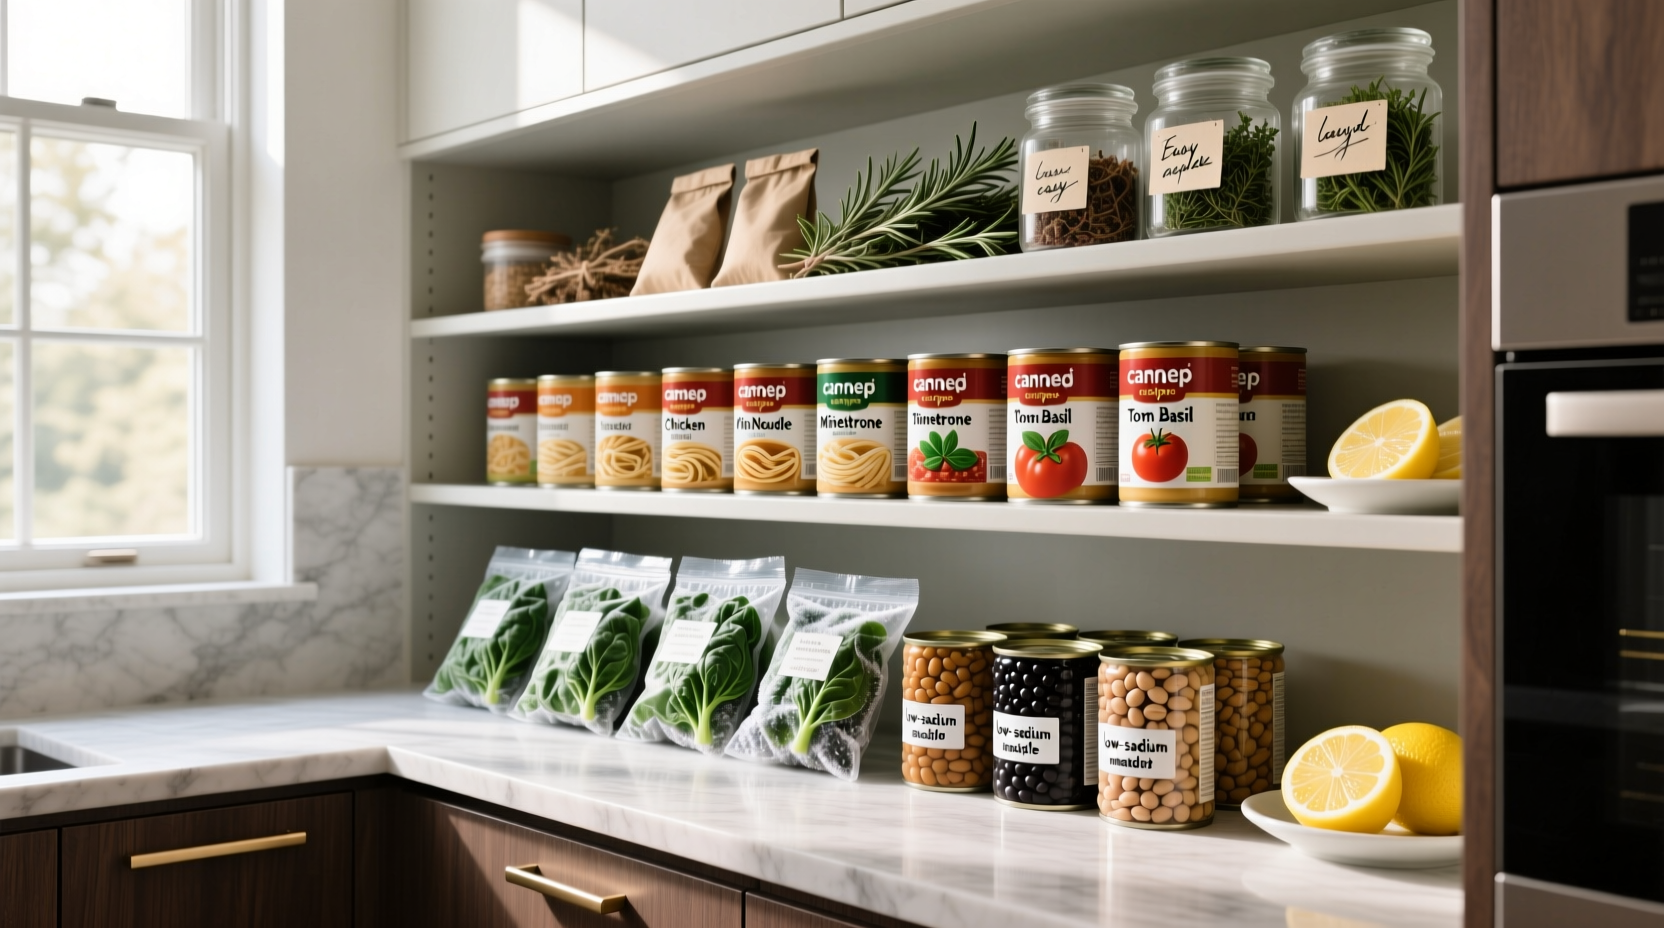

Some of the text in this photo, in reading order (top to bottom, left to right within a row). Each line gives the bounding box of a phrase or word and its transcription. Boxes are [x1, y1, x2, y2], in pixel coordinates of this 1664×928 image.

[1015, 367, 1074, 389] canned
[1041, 408, 1072, 424] Basil
[1127, 406, 1194, 423] Tom Basil
[665, 417, 706, 431] Chicken
